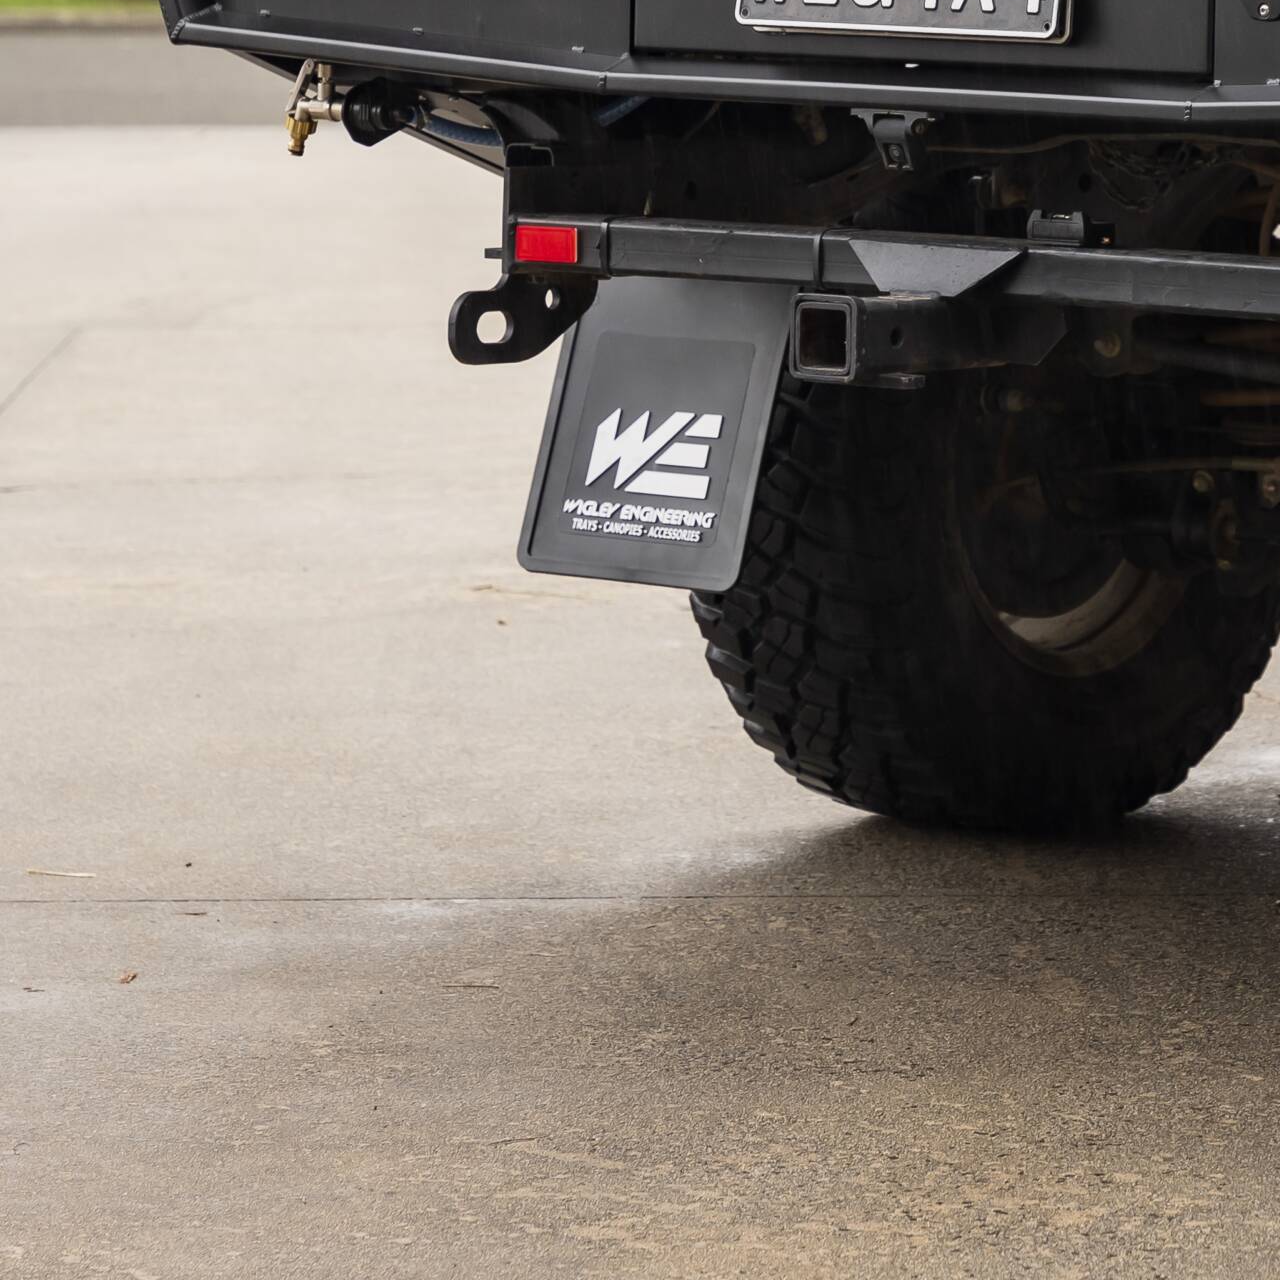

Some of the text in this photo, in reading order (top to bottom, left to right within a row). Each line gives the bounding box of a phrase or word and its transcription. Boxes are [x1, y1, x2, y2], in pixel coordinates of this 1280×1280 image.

[562, 498, 716, 529] WIGLEY ENGINEERING
[572, 518, 597, 532] TRAYS
[603, 521, 643, 536] CANOPIES
[648, 526, 701, 542] ACCESSORIES
